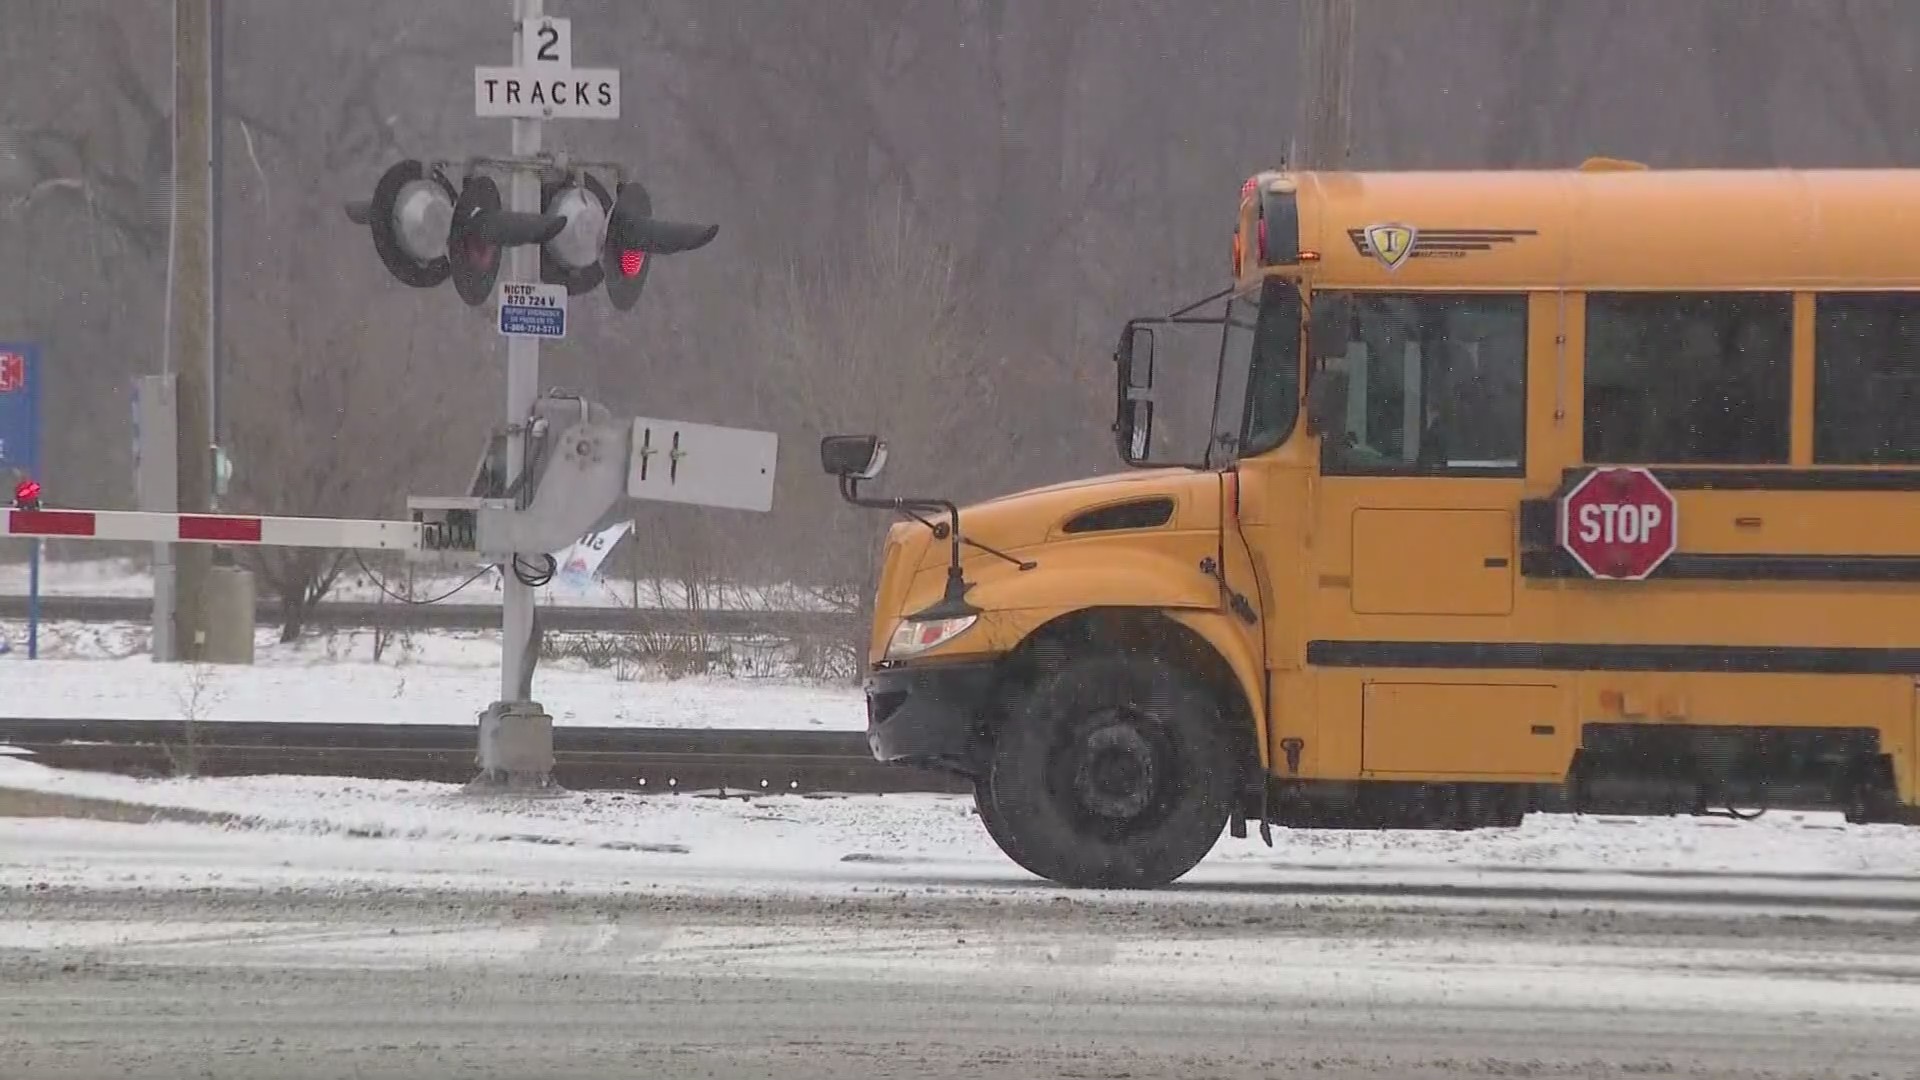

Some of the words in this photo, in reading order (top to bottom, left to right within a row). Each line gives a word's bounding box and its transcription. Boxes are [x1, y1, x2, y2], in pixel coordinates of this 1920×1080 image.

[537, 27, 559, 61] 2
[484, 79, 612, 106] TRACKS
[507, 295, 526, 305] 870
[528, 295, 546, 306] 724
[549, 296, 555, 307] V
[1579, 503, 1662, 544] STOP
